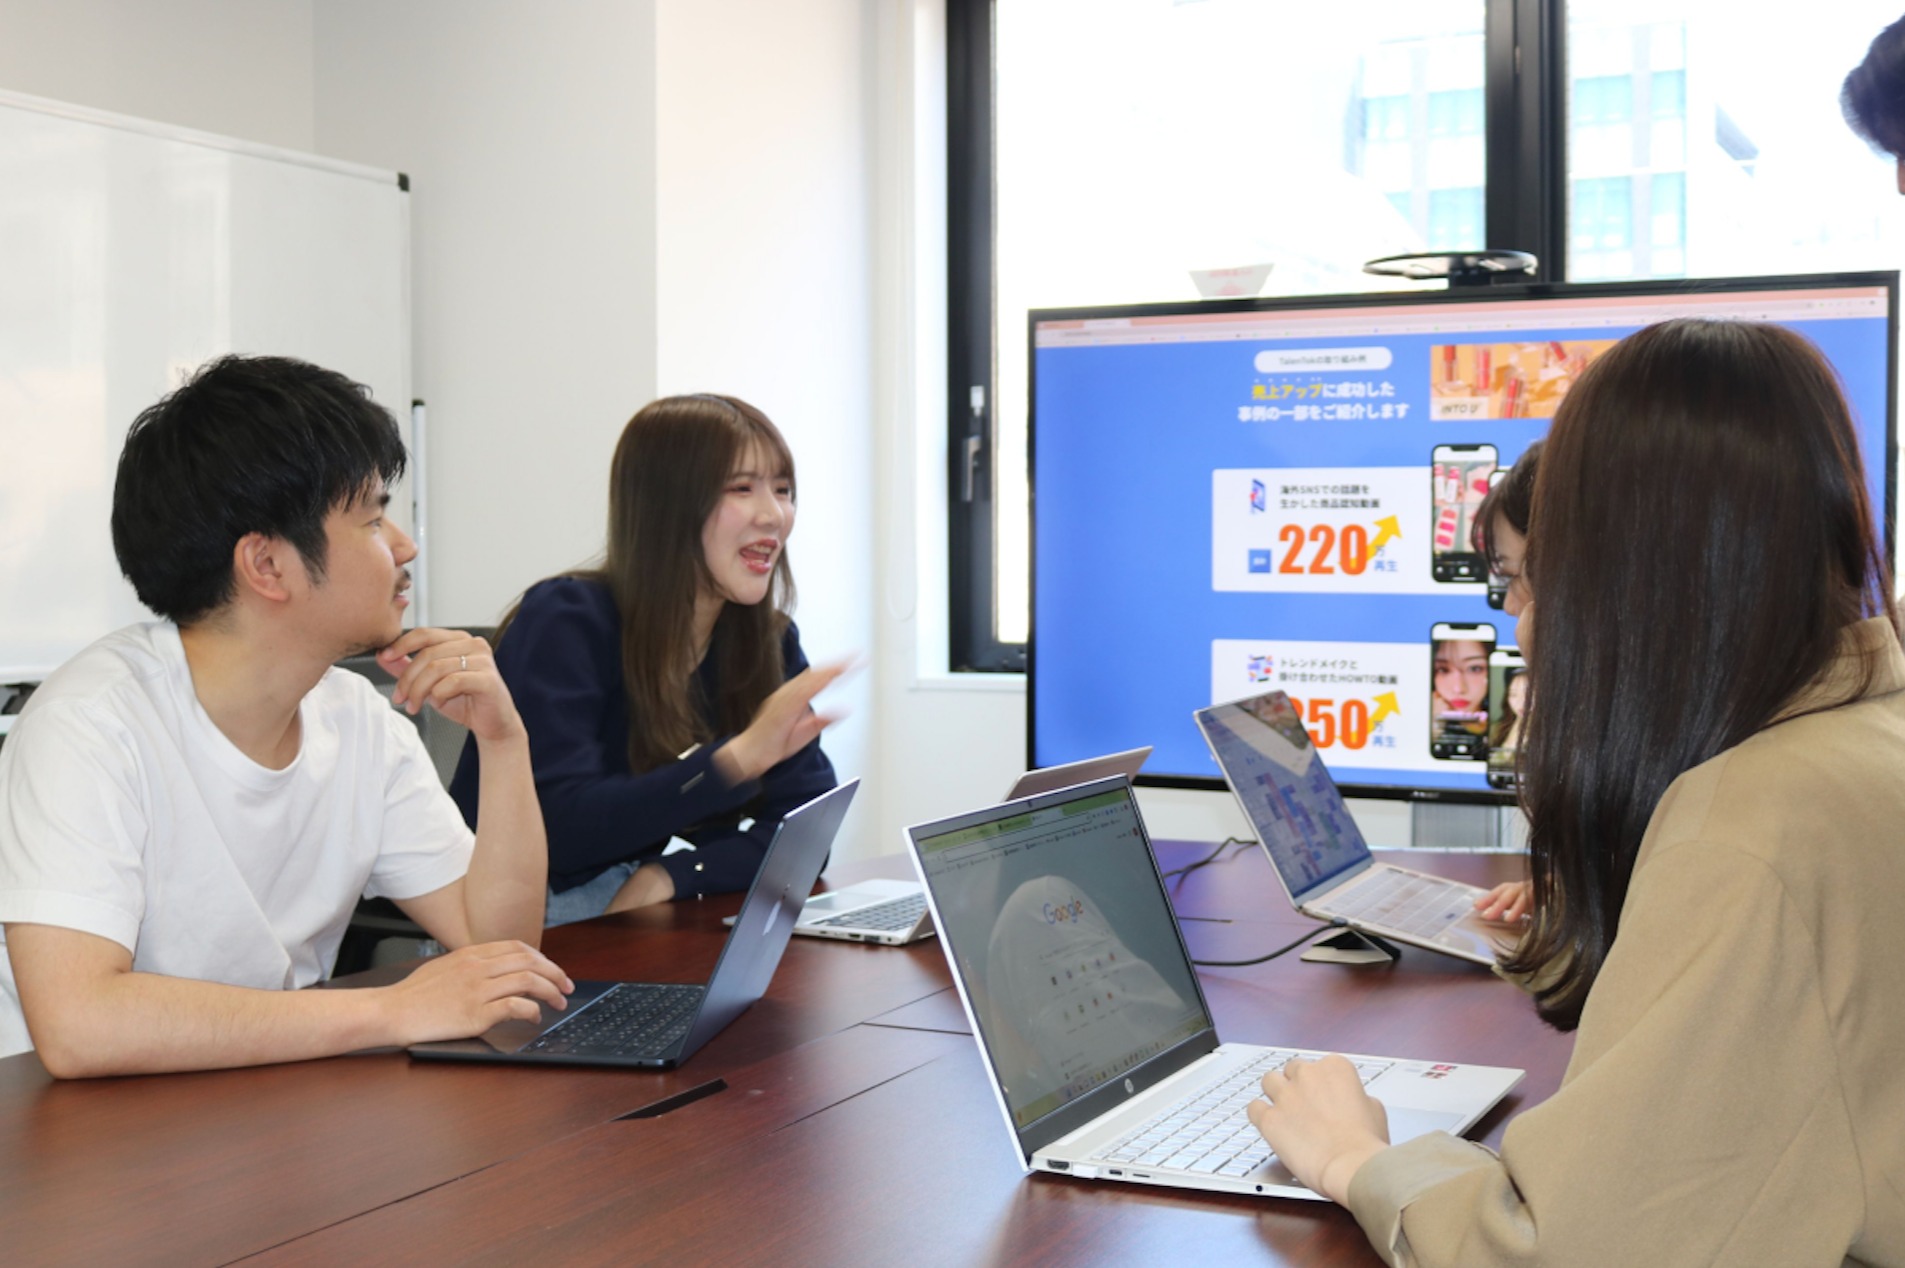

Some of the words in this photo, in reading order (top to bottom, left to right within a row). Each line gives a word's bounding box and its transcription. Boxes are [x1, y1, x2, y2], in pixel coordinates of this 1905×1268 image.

[1252, 382, 1395, 400] 売上アップに成功した
[1238, 403, 1409, 421] 事例の一部をご紹介します
[1278, 523, 1367, 575] 220
[1374, 560, 1398, 572] 再生
[1280, 659, 1358, 670] トレンドメイクと
[1289, 697, 1368, 750] 50
[1373, 735, 1396, 747] 再生
[1043, 897, 1084, 925] Google
